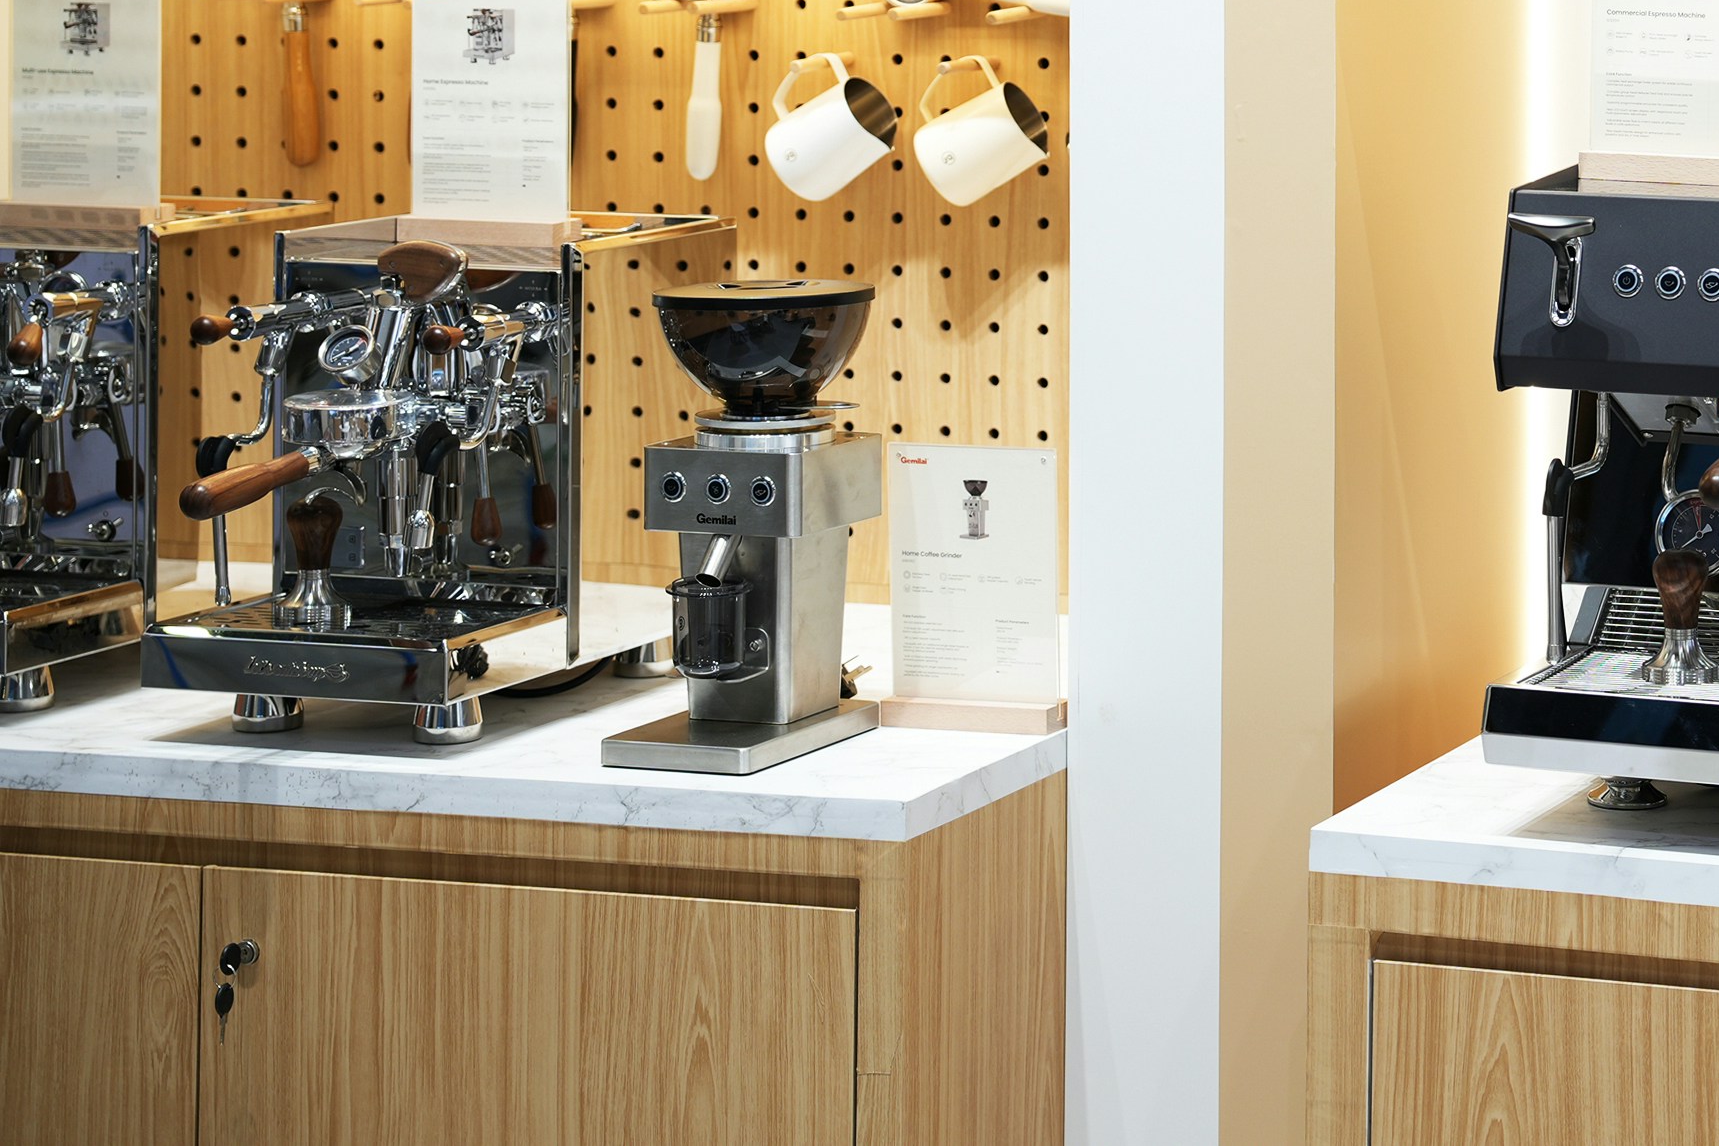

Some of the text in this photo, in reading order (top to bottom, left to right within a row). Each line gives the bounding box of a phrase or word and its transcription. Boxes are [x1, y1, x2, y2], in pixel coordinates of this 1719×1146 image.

[1606, 9, 1647, 17] Commercial
[1648, 10, 1676, 19] Espresso
[900, 456, 928, 465] Gemilai
[696, 513, 736, 525] Gemilai
[940, 551, 962, 559] Grinder
